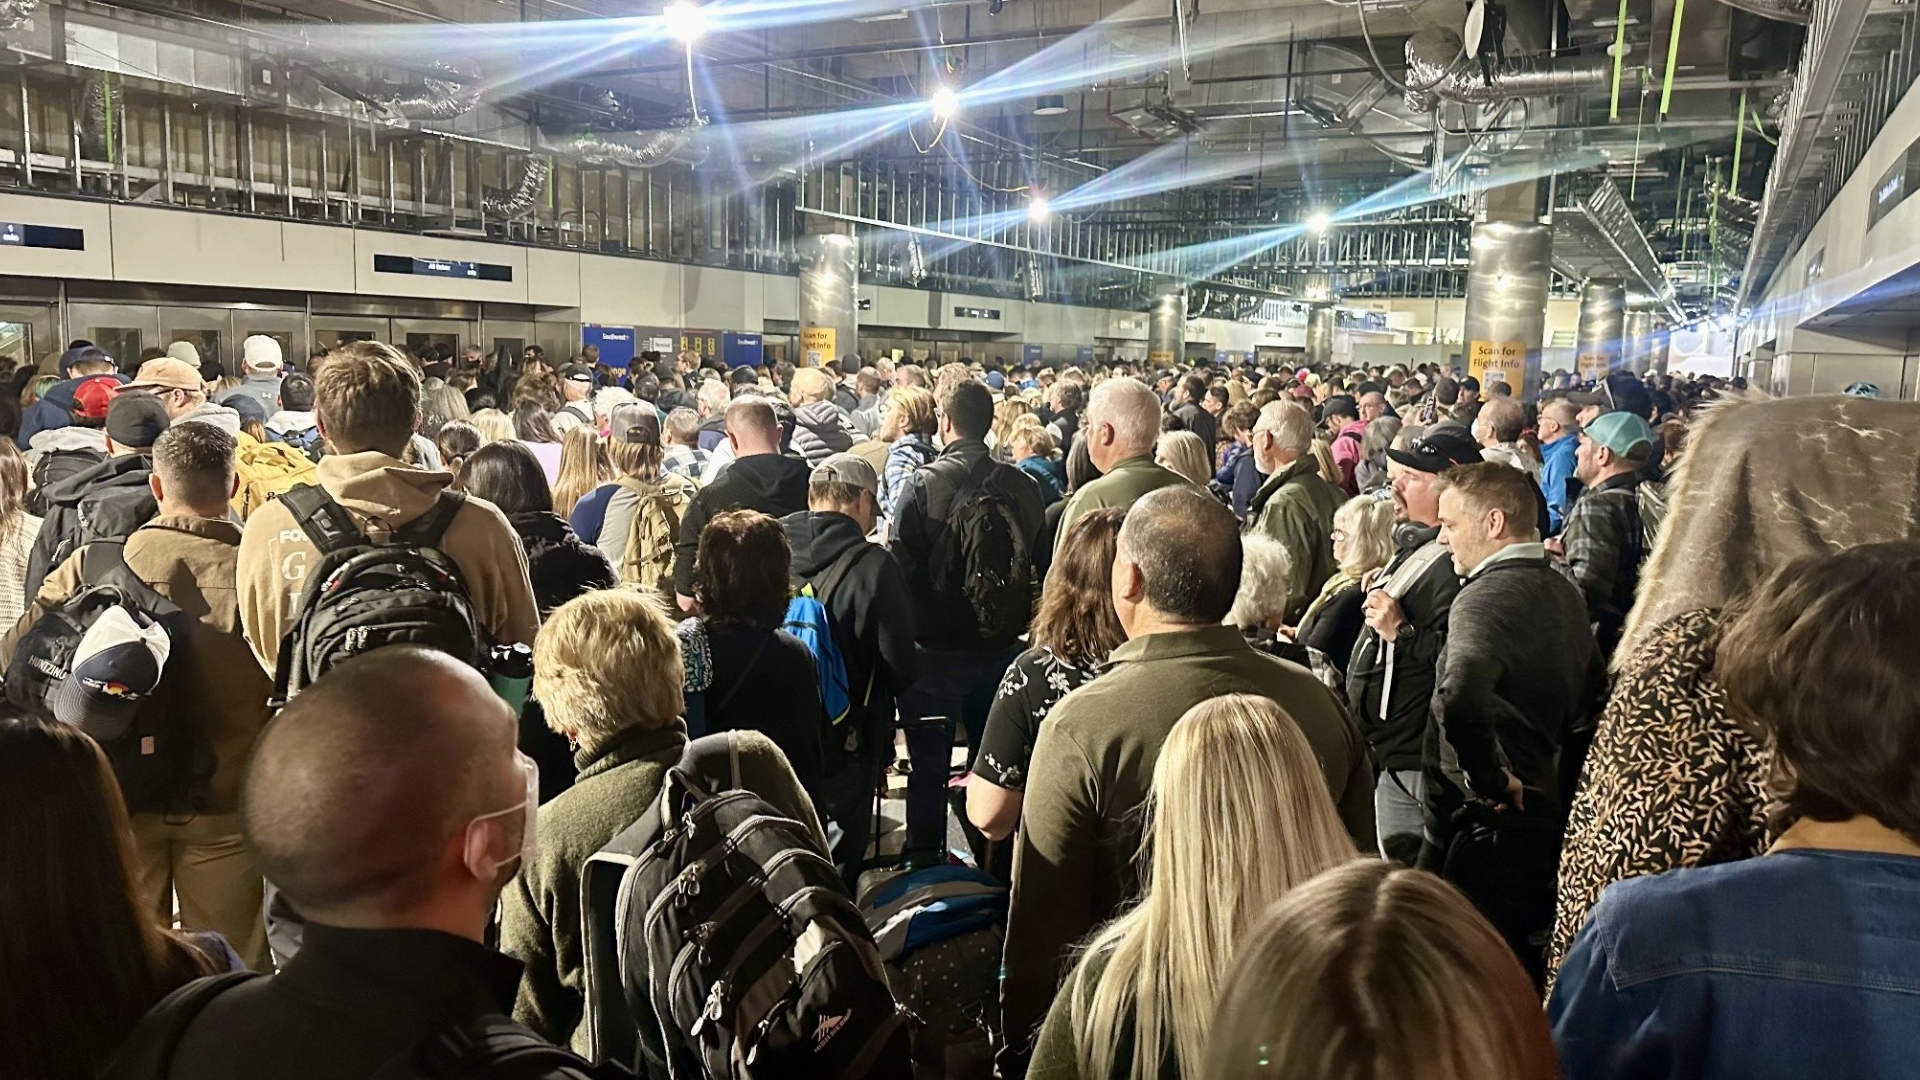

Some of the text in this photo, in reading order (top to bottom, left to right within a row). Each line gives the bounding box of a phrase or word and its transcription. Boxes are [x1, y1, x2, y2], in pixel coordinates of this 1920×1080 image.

[817, 331, 828, 340] for
[816, 341, 832, 349] Info
[1478, 345, 1516, 356] Scan for
[1473, 358, 1520, 370] Flight Info
